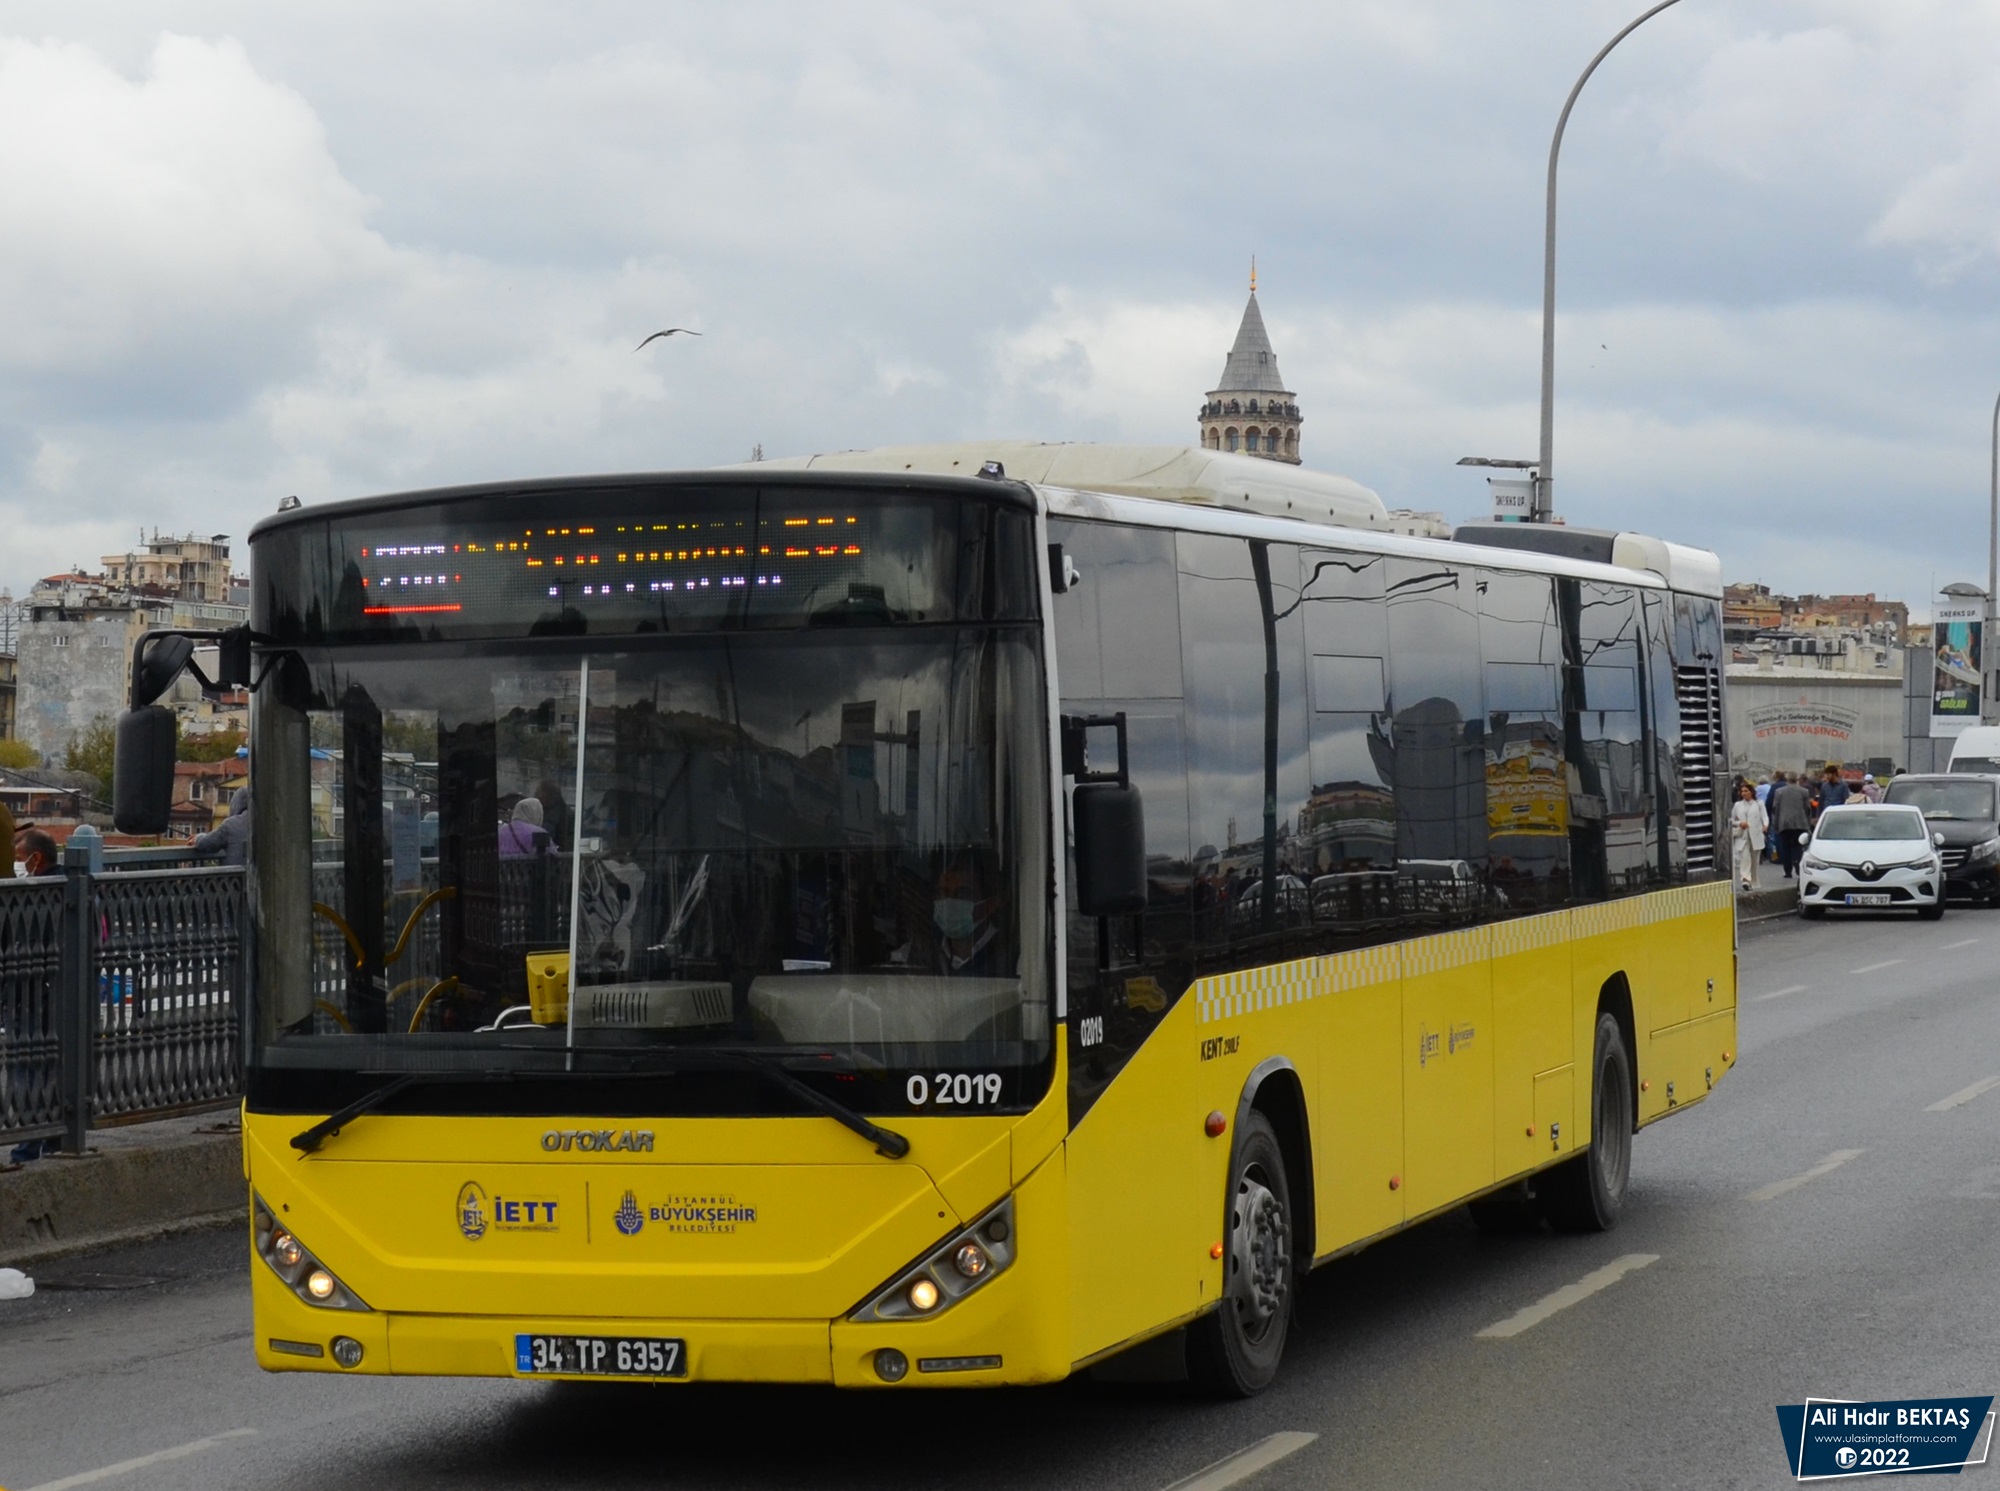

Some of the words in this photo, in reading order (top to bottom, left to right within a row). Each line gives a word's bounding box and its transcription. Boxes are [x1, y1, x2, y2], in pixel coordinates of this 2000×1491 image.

[1780, 725, 1797, 735] 150
[1200, 1036, 1223, 1062] KENT
[935, 1073, 1002, 1104] 2019
[541, 1129, 655, 1153] OTOKAR
[494, 1196, 558, 1223] İETT
[650, 1203, 755, 1227] BÜYÜKŞEHİR
[519, 1354, 531, 1363] TR
[532, 1338, 563, 1371] 34
[575, 1339, 607, 1370] TP
[617, 1340, 680, 1372] 6357
